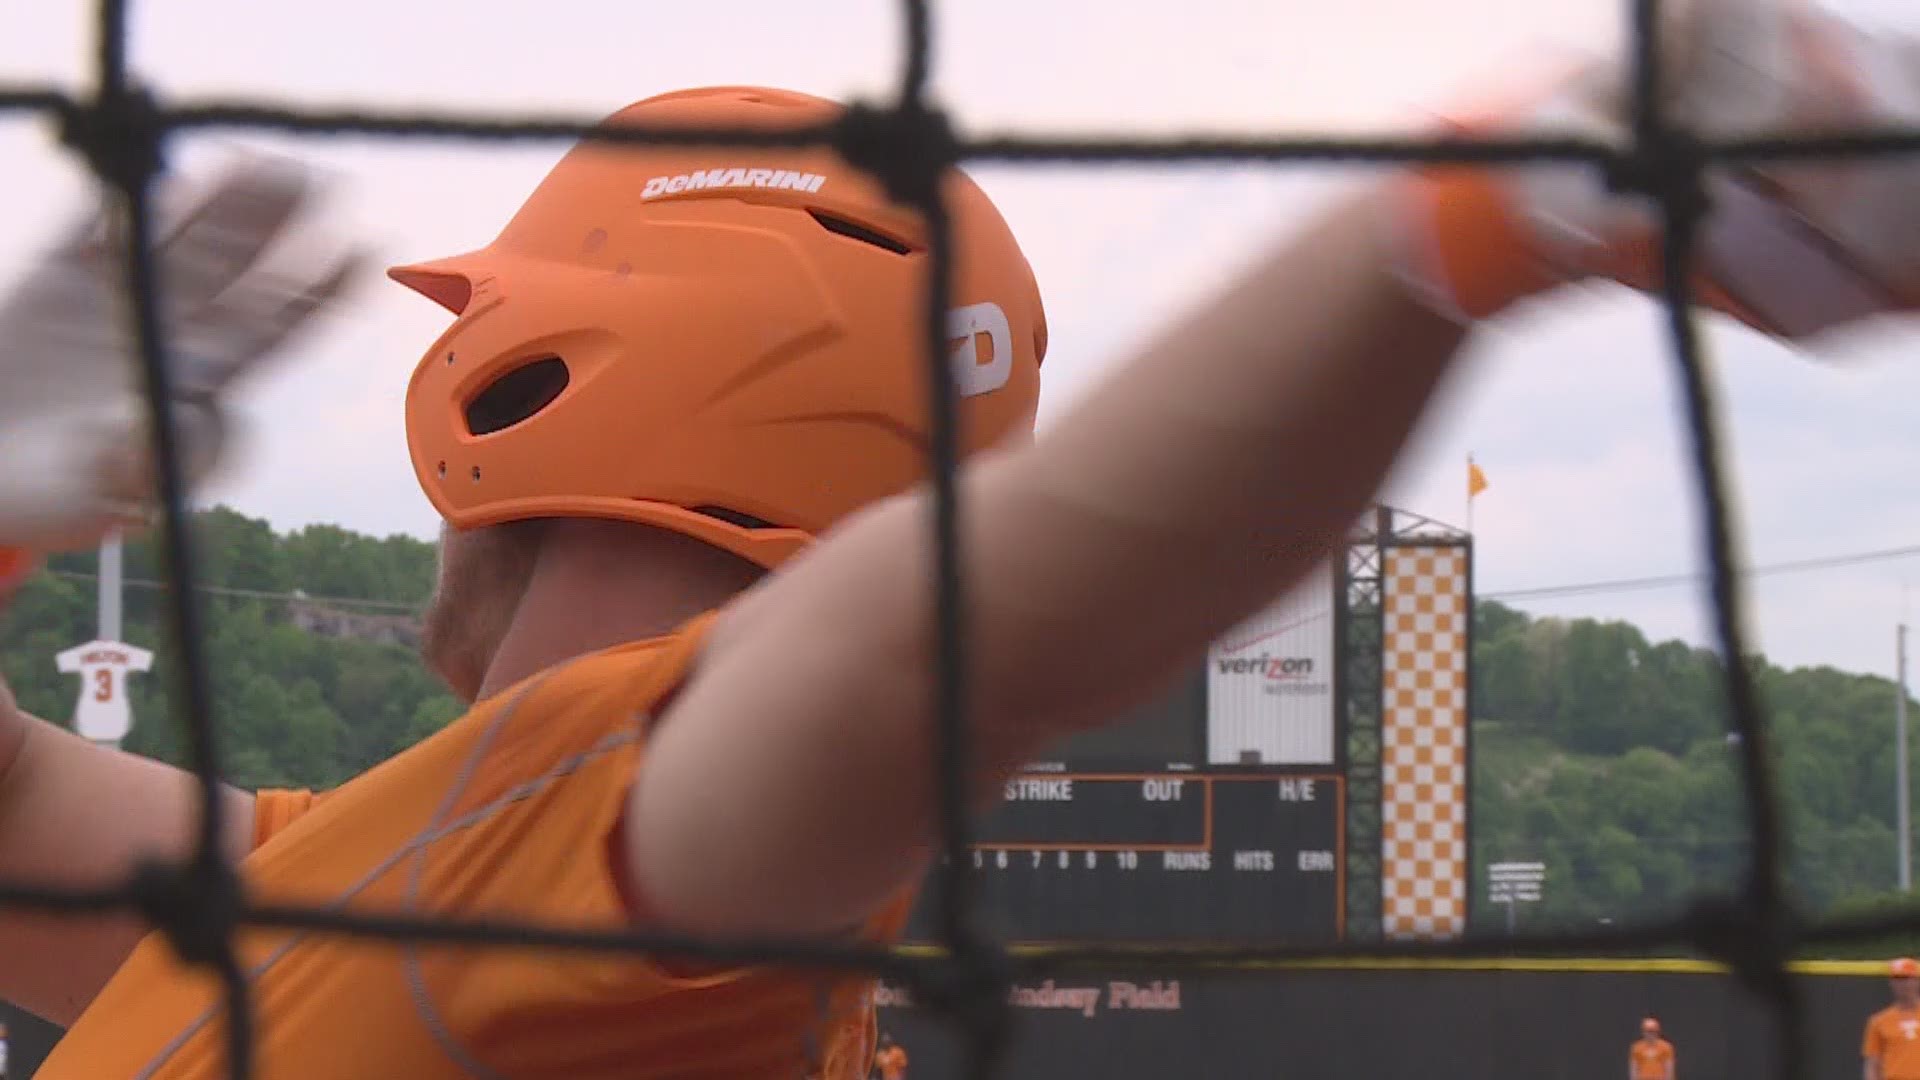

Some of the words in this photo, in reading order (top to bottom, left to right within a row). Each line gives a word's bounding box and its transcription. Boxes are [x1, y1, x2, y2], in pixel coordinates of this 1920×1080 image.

[641, 168, 827, 198] DeMARINI
[1218, 652, 1314, 679] verizon
[95, 669, 112, 702] 3
[1006, 780, 1073, 801] STRIKE
[1142, 780, 1184, 801] OUT
[1279, 780, 1316, 801] H/E
[997, 852, 1008, 868] 6
[1032, 852, 1041, 868] 7
[1058, 852, 1069, 868] 8
[1086, 852, 1096, 868] 9
[1118, 852, 1138, 870] 10
[1163, 852, 1212, 870] RUNS
[1234, 852, 1275, 870] HITS
[1298, 852, 1335, 870] ERR
[1008, 980, 1100, 1017] indsay
[1108, 980, 1180, 1009] Field
